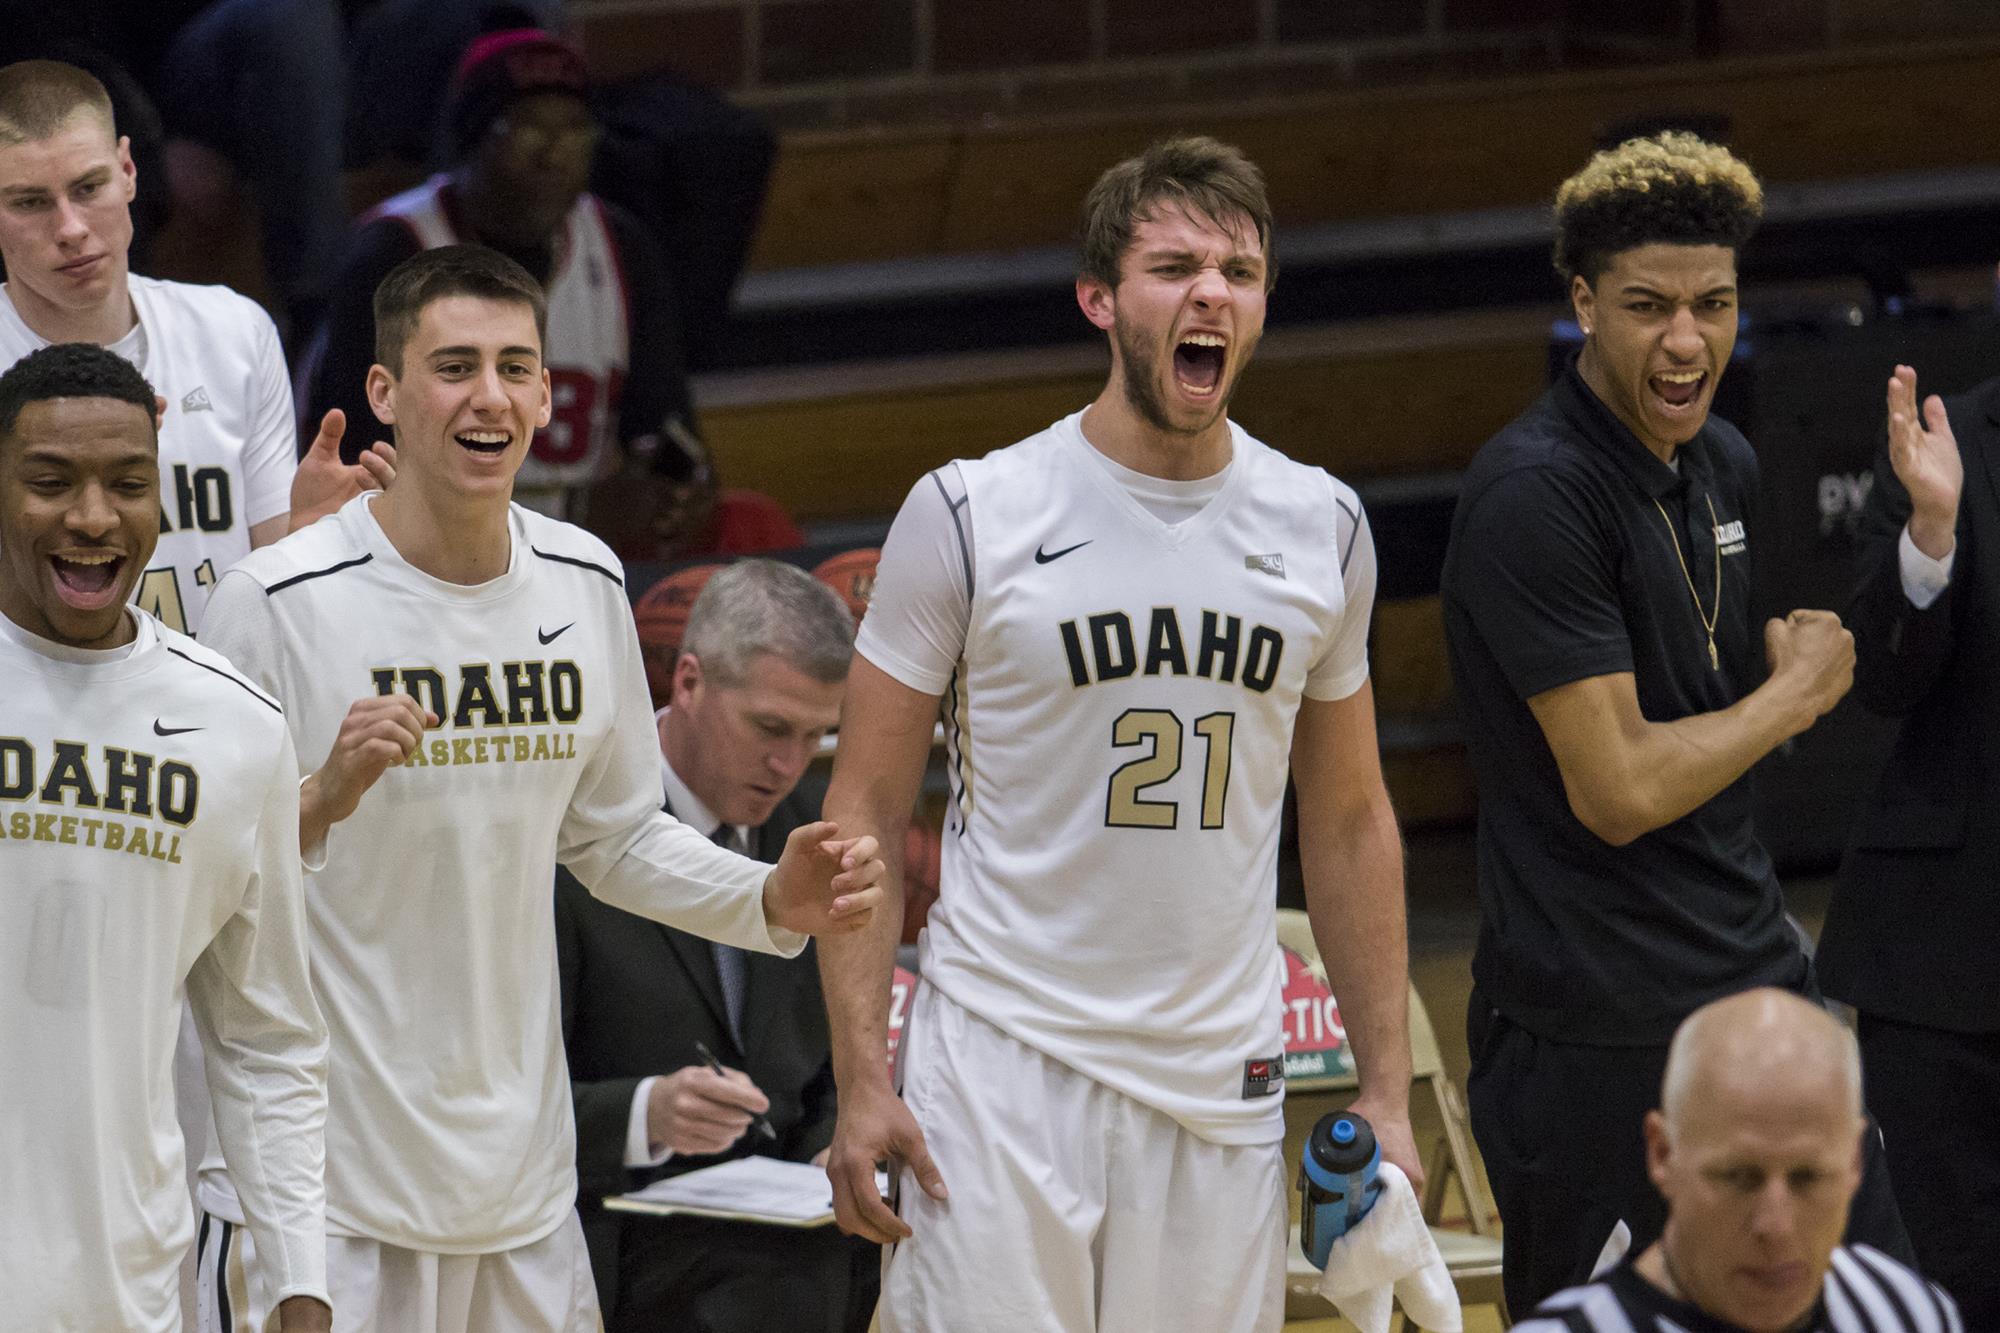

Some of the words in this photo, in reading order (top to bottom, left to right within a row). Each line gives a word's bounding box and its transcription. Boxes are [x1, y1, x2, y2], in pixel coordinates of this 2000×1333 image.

[160, 462, 234, 534] HO
[1059, 606, 1284, 693] IDAHO
[388, 733, 577, 768] ASKETBALL
[1104, 708, 1235, 830] 21
[0, 811, 182, 864] SKETBALL
